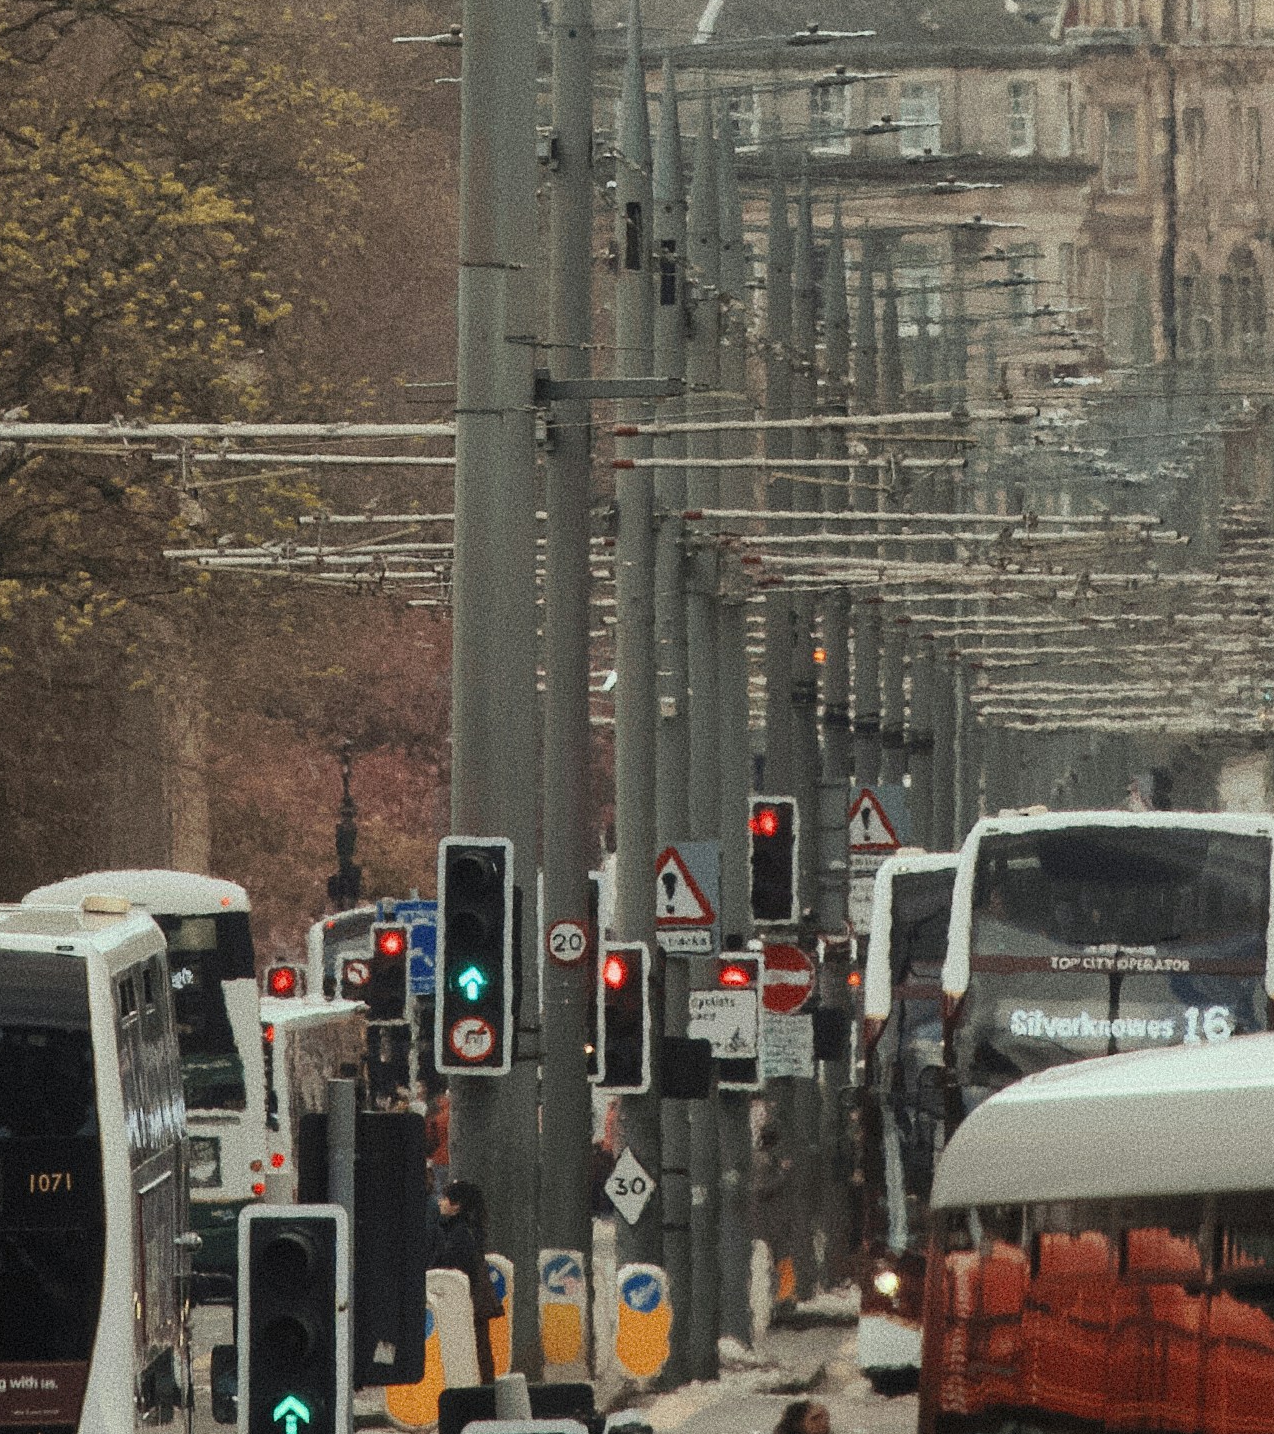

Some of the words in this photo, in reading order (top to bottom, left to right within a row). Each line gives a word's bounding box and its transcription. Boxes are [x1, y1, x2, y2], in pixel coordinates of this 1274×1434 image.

[551, 932, 583, 952] 20
[1183, 1005, 1233, 1047] 16
[27, 1172, 73, 1194] 1071
[613, 1175, 647, 1197] 30
[9, 1373, 38, 1390] with
